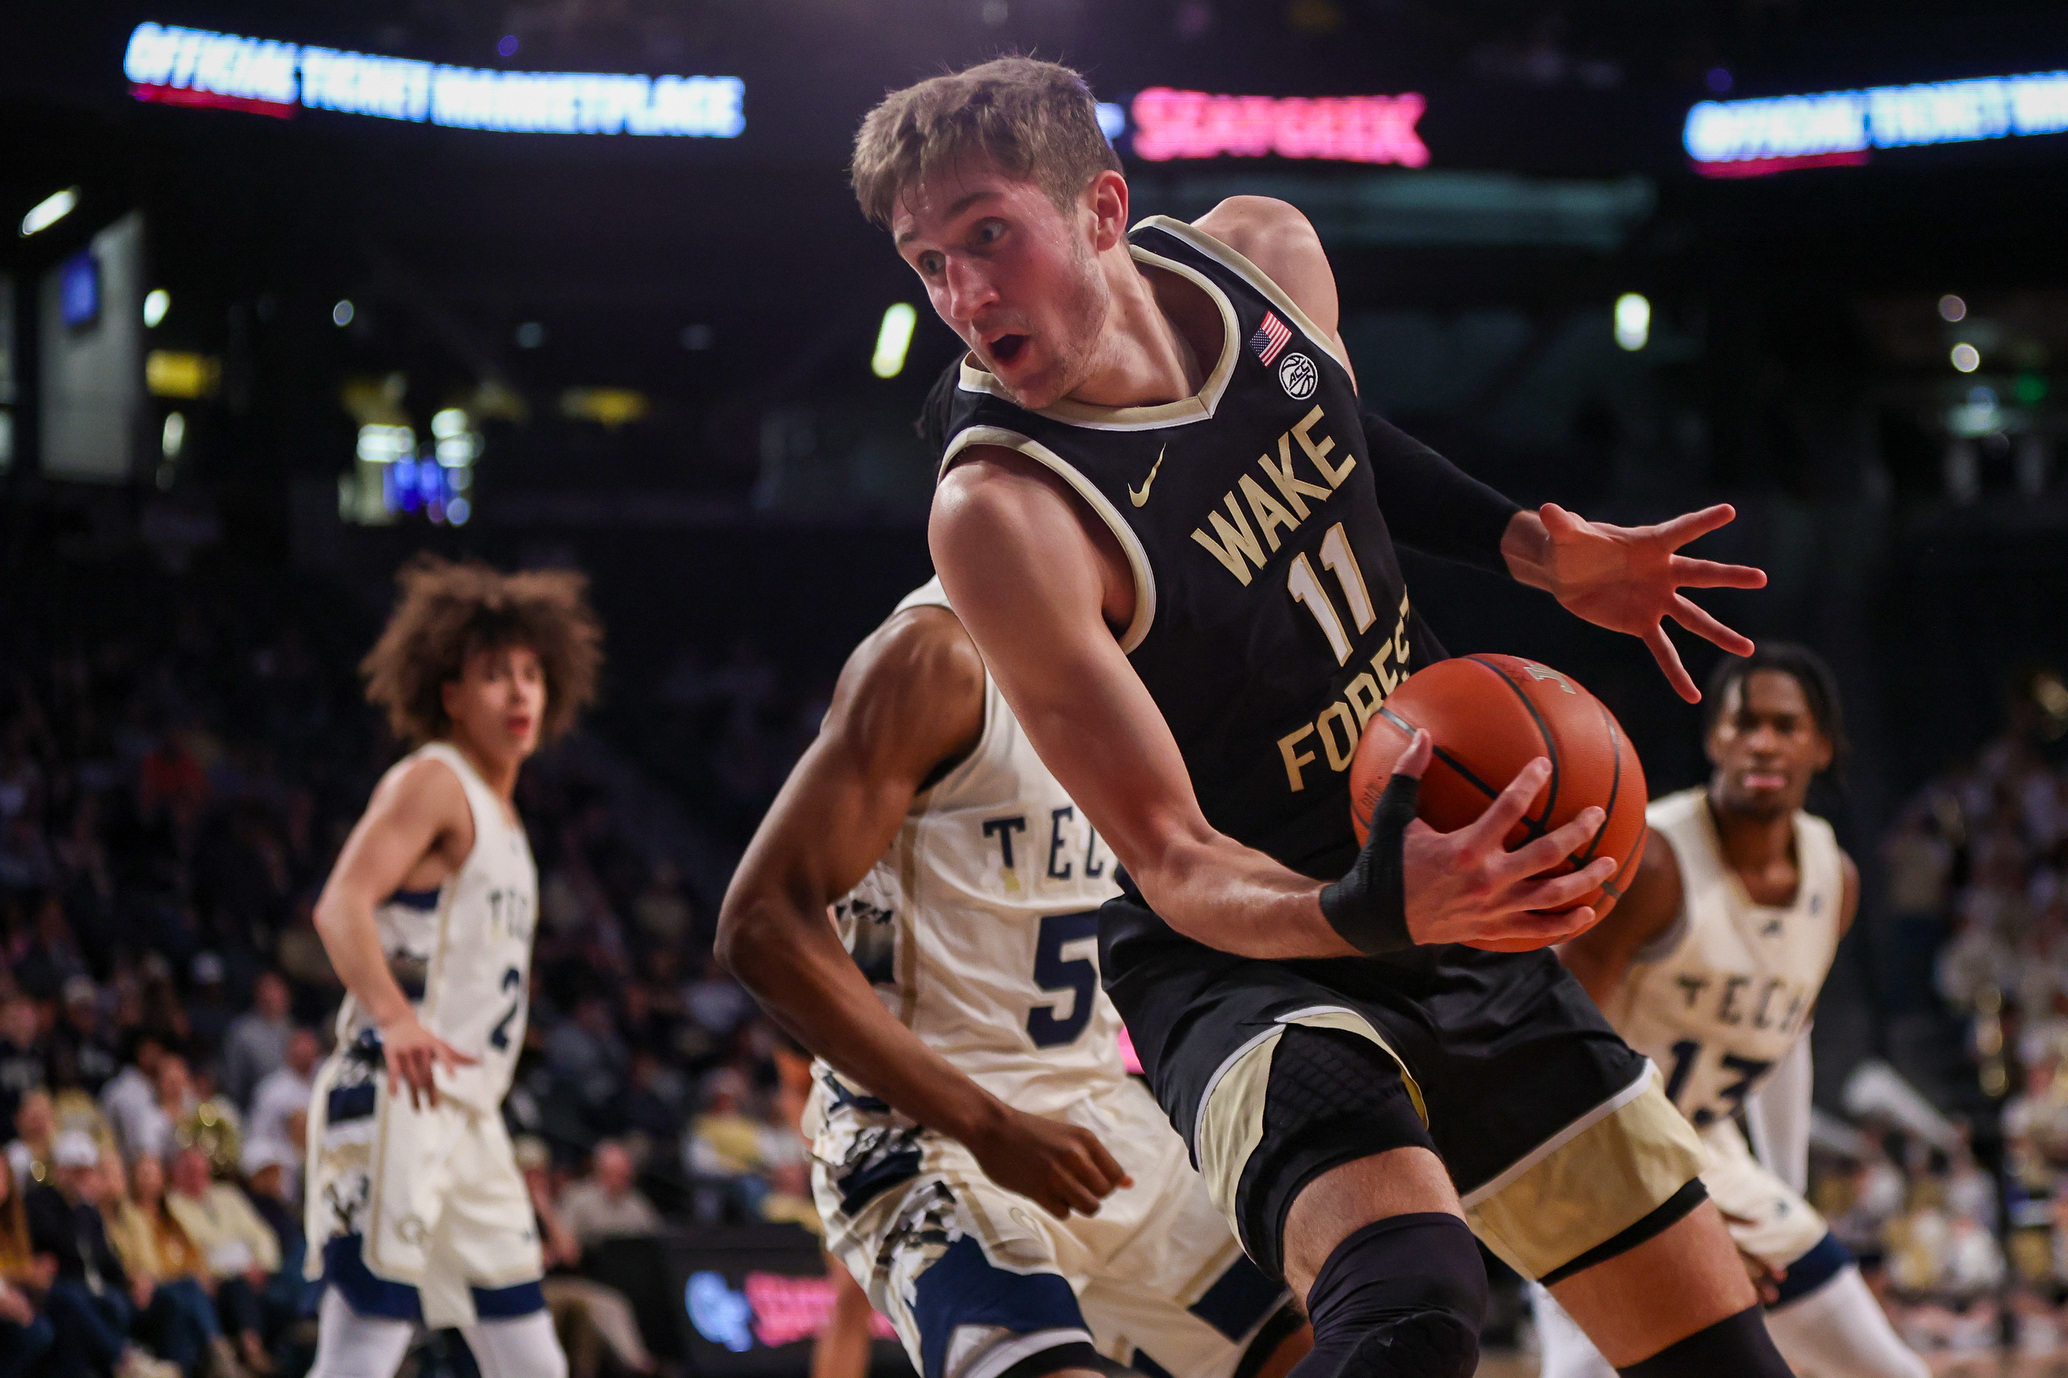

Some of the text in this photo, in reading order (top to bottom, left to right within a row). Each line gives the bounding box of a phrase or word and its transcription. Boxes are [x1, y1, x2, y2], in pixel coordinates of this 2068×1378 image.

[1190, 404, 1357, 587] WAKE
[1287, 522, 1377, 668] 11
[1277, 583, 1410, 793] FORES
[982, 806, 1104, 880] TEC
[490, 966, 520, 1054] 2
[1027, 909, 1100, 1050] 5
[1664, 1039, 1774, 1127] 13
